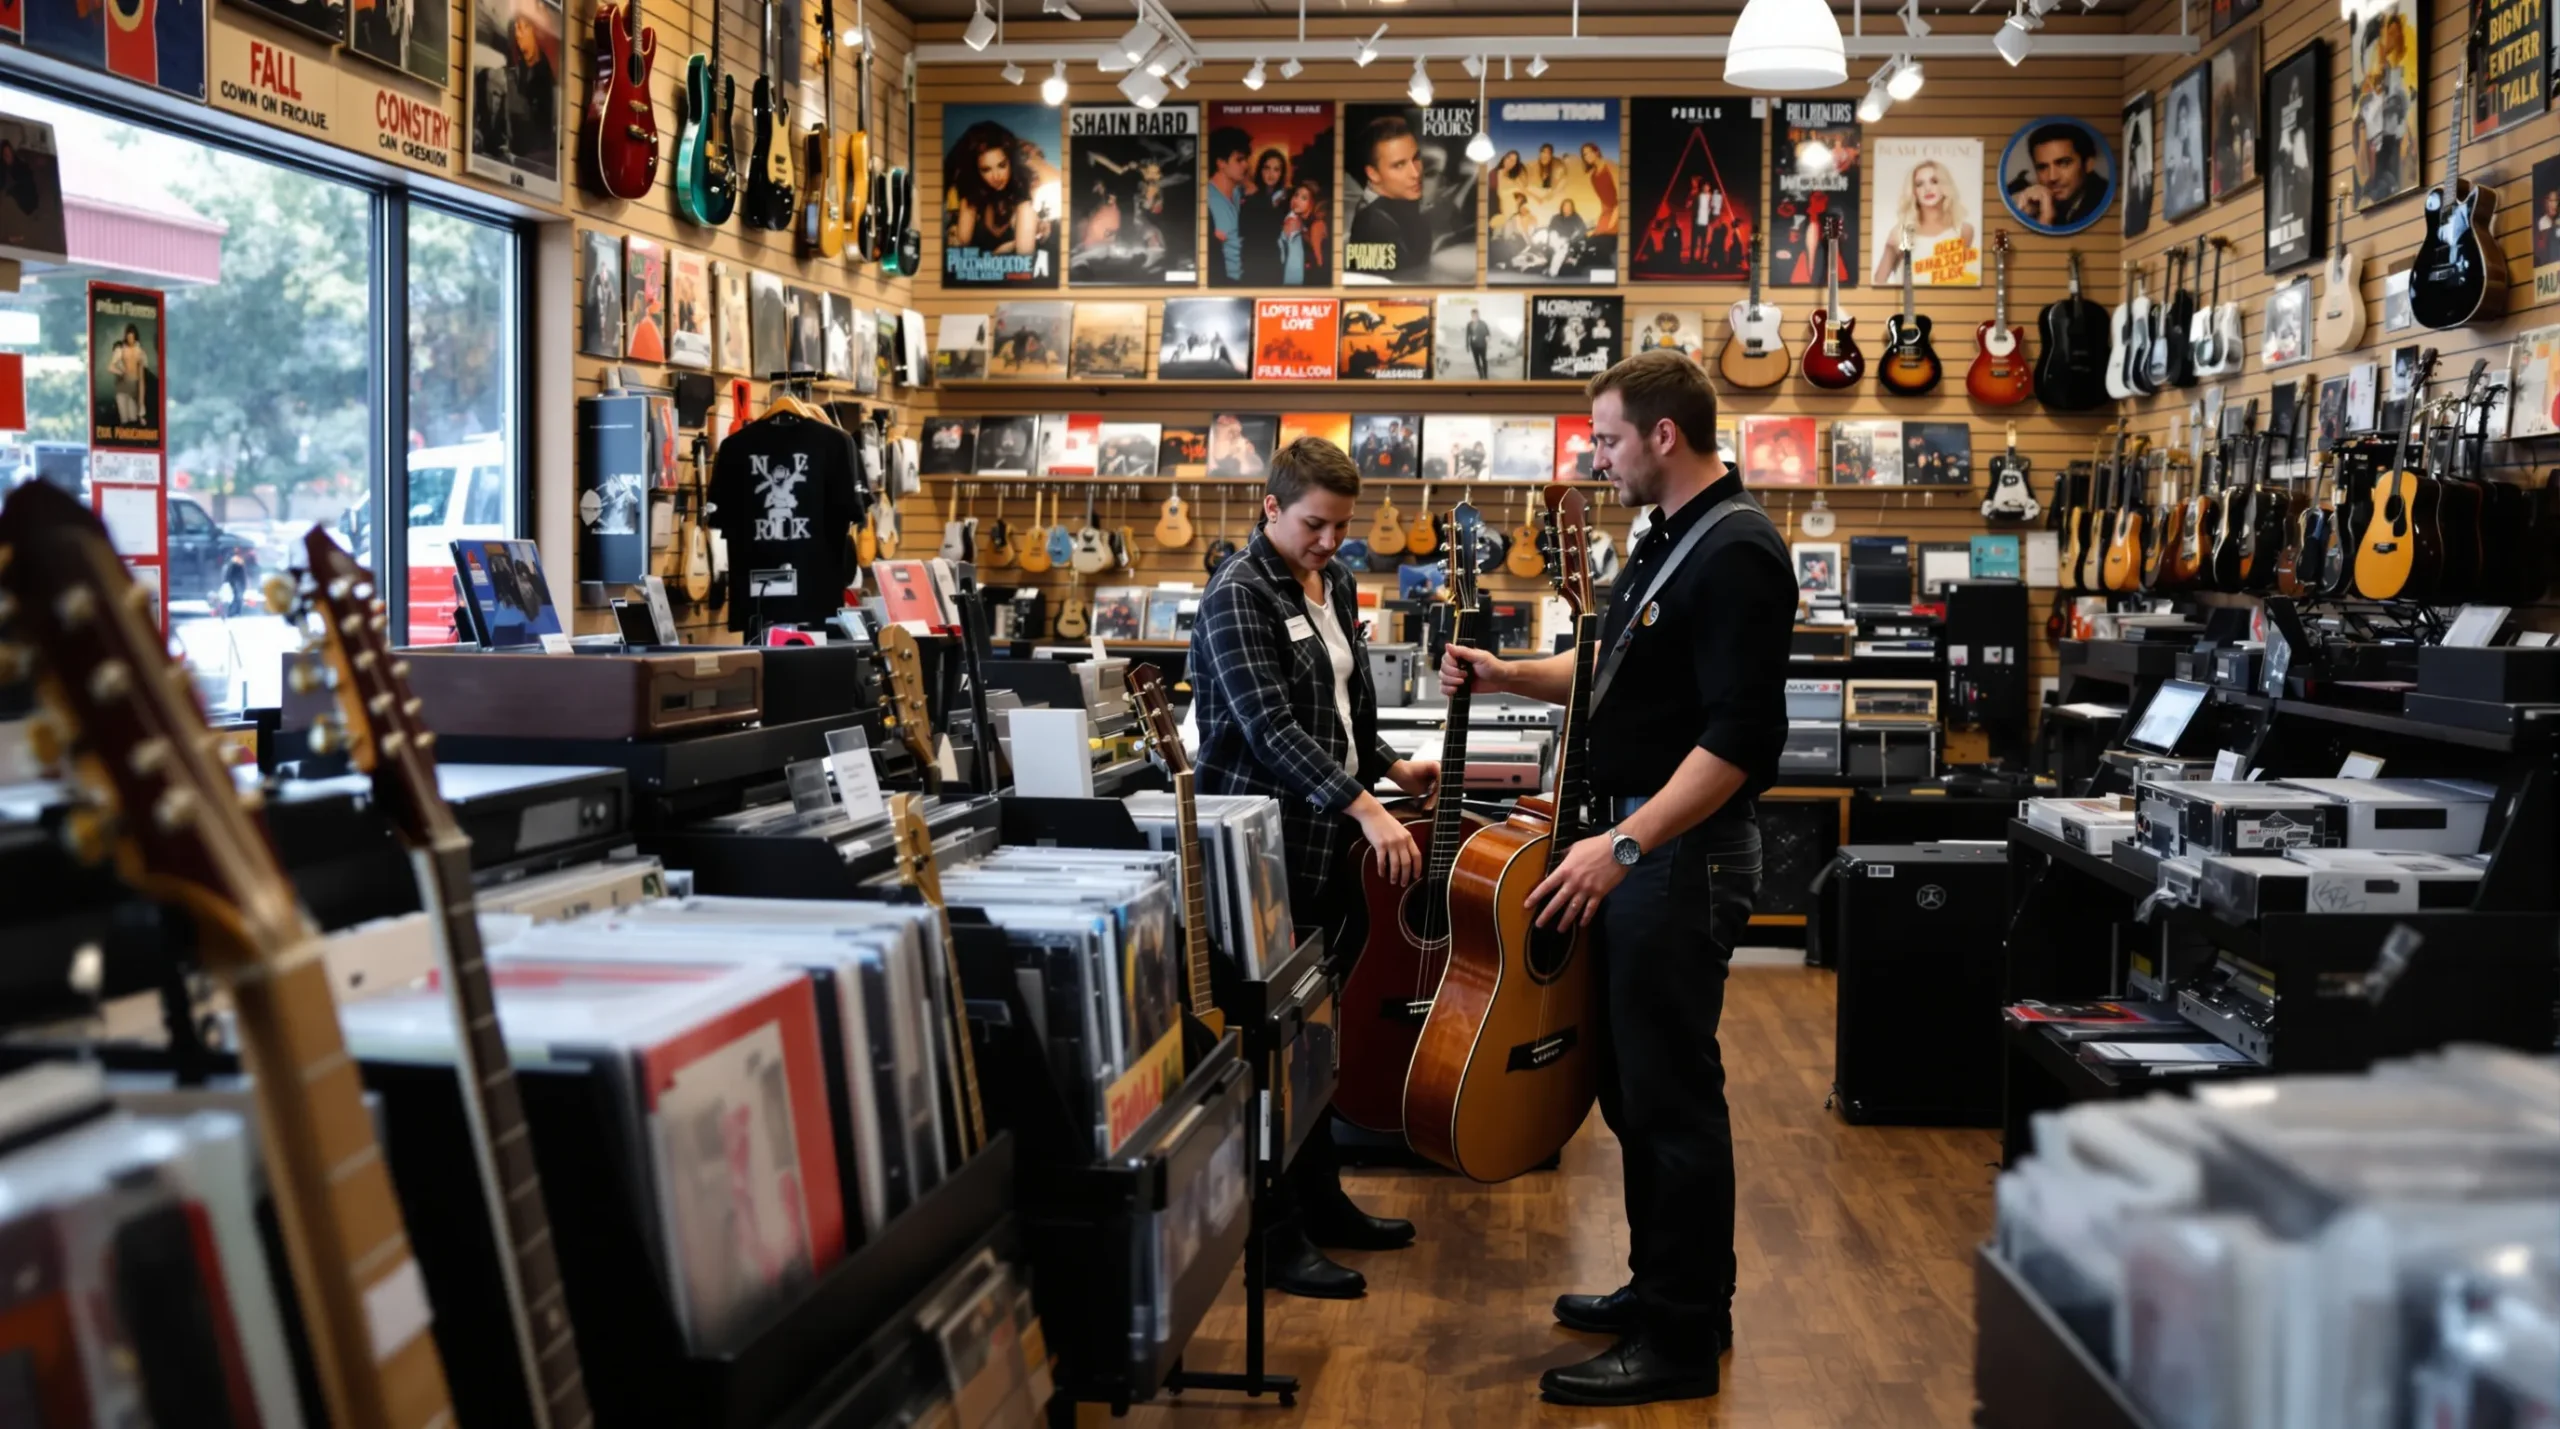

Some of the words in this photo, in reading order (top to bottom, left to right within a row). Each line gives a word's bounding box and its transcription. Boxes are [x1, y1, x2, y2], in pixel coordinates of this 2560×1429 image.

[250, 41, 302, 101] FALL
[2501, 69, 2540, 112] TALK
[261, 94, 277, 114] ON
[375, 89, 451, 149] CONSTRY
[1136, 111, 1188, 134] BARD
[378, 133, 398, 151] CAN
[1281, 318, 1315, 331] LOVE
